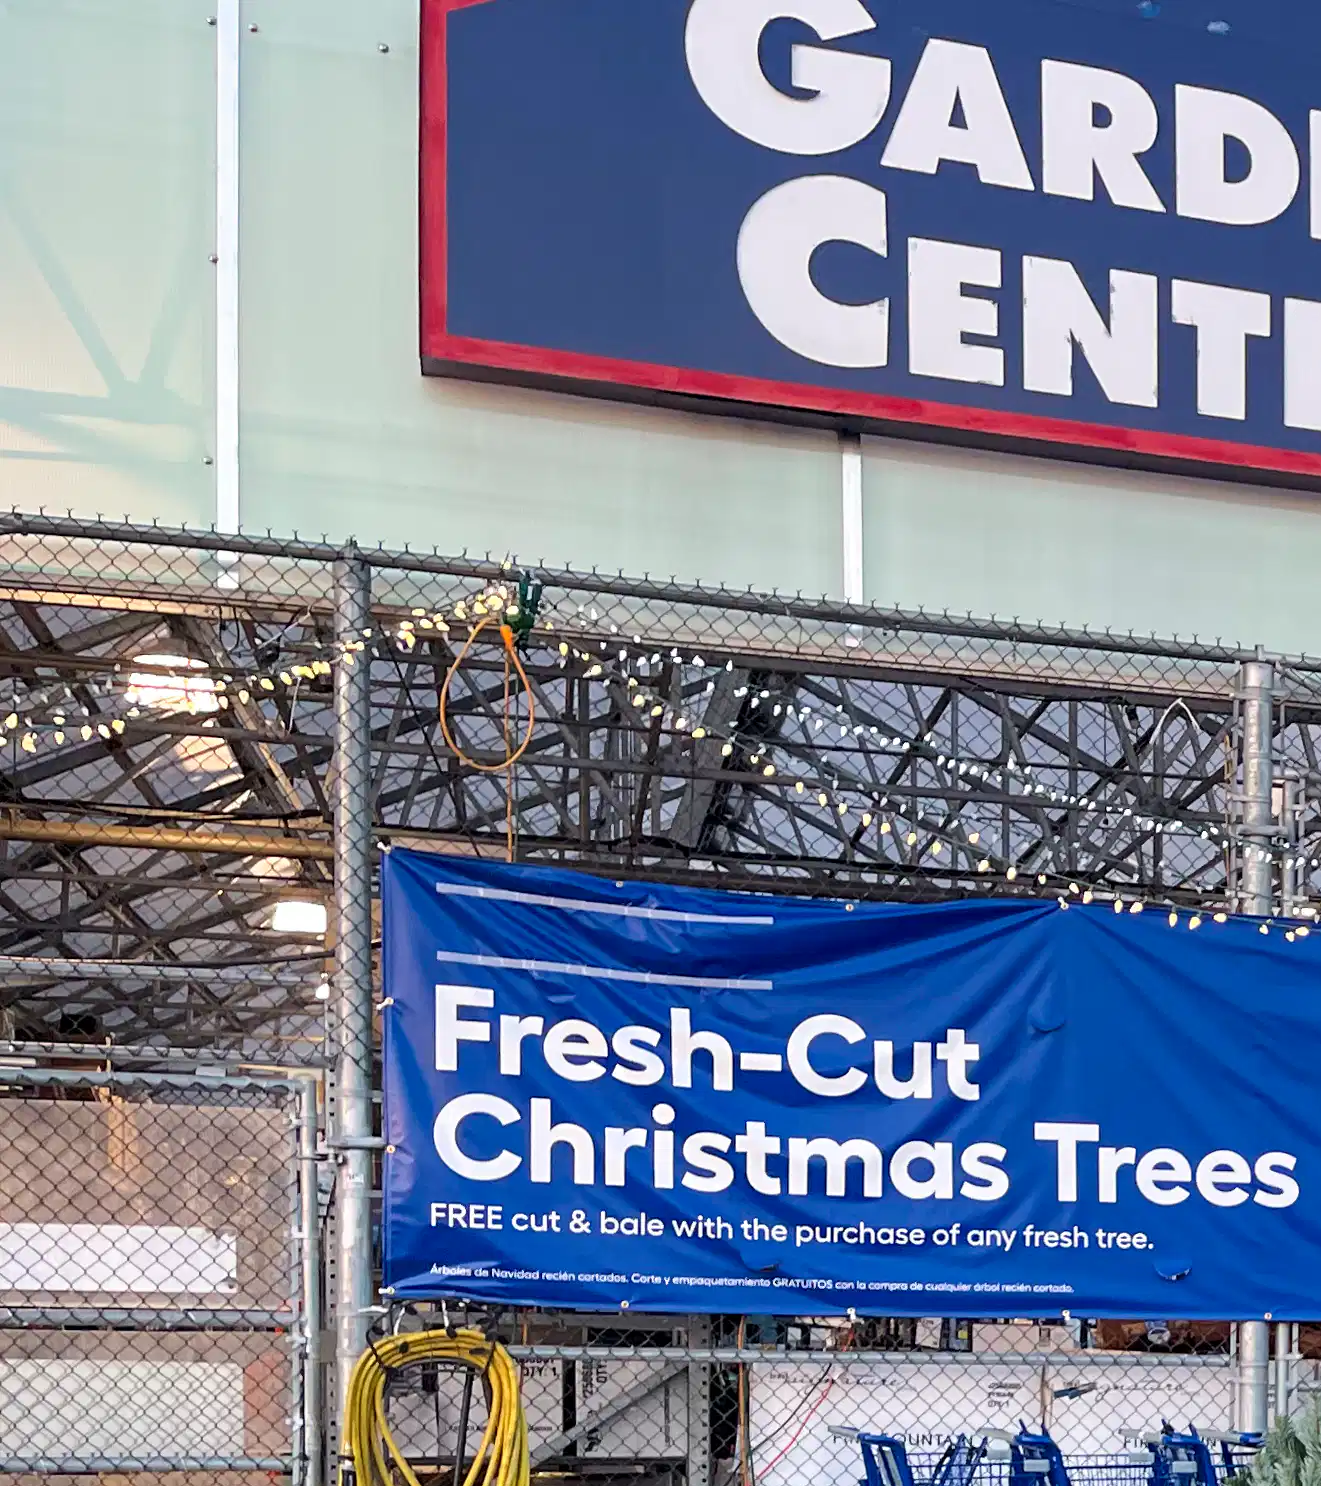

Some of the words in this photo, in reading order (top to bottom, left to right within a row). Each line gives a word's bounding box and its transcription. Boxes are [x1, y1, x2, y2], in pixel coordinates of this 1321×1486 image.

[434, 983, 980, 1101] Fresh-Cut
[433, 1093, 1009, 1201] Christmas
[1034, 1122, 1300, 1208] Trees
[430, 1202, 503, 1230] FREE
[511, 1210, 561, 1233] cut
[569, 1209, 591, 1234] &
[600, 1210, 665, 1237] bale
[671, 1216, 734, 1240] with
[740, 1217, 788, 1242] the
[795, 1221, 926, 1248] purchase
[932, 1223, 961, 1246] of
[966, 1229, 1017, 1252] any
[1022, 1224, 1089, 1248] fresh
[1095, 1228, 1154, 1250] tree.
[429, 1262, 472, 1277] Árboles
[473, 1267, 489, 1277] de
[491, 1268, 540, 1280] Navidad
[541, 1270, 576, 1281] recién
[630, 1272, 662, 1284] Corte
[663, 1276, 671, 1286] y
[772, 1277, 833, 1290] GRATUITOS
[834, 1281, 855, 1290] con
[856, 1280, 867, 1290] la
[868, 1282, 909, 1293] compra
[910, 1281, 924, 1291] de
[925, 1282, 972, 1294] cualquier
